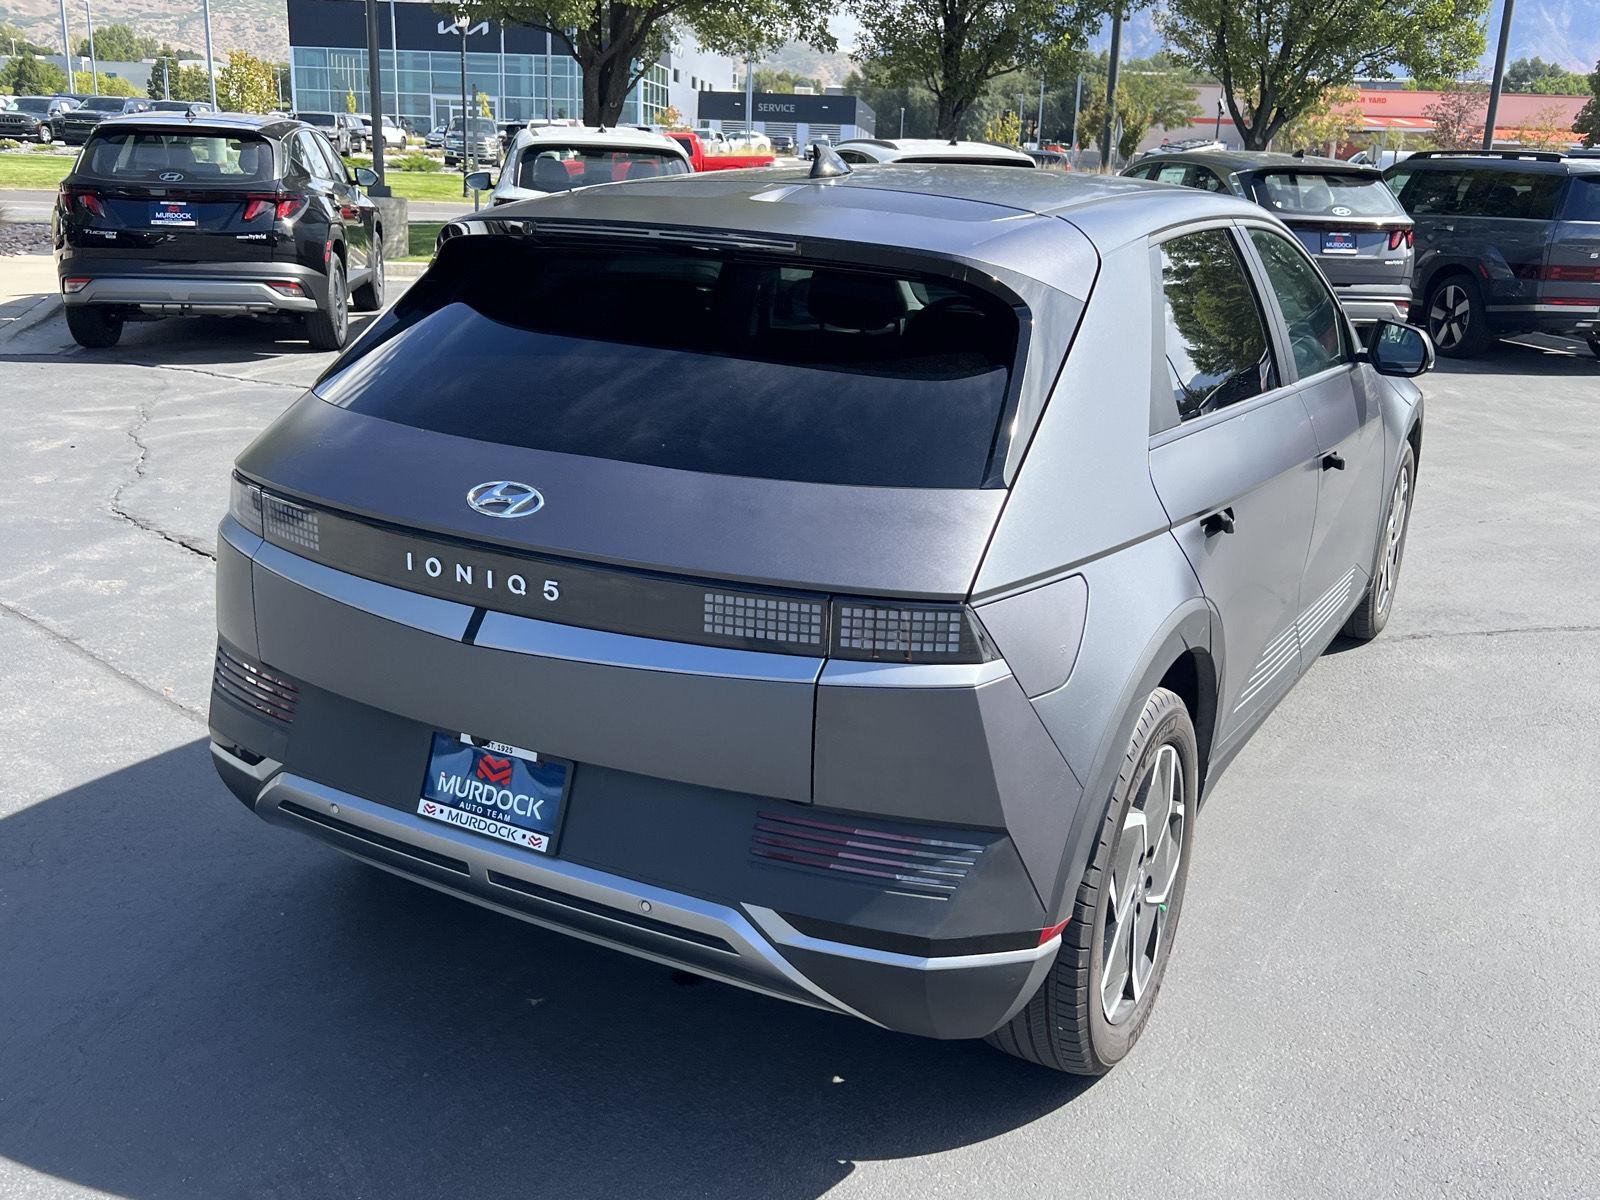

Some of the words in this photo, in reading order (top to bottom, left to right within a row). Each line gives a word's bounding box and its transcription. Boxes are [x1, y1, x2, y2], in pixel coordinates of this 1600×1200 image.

[437, 20, 489, 36] KA
[757, 103, 796, 113] SERVICE
[407, 552, 527, 596] IONIQ
[543, 580, 560, 602] 5
[497, 744, 513, 754] 1925
[437, 772, 544, 820] MURDOCK
[459, 801, 483, 814] AUTO
[486, 809, 511, 822] TEAM
[447, 810, 518, 841] MURDOCK
